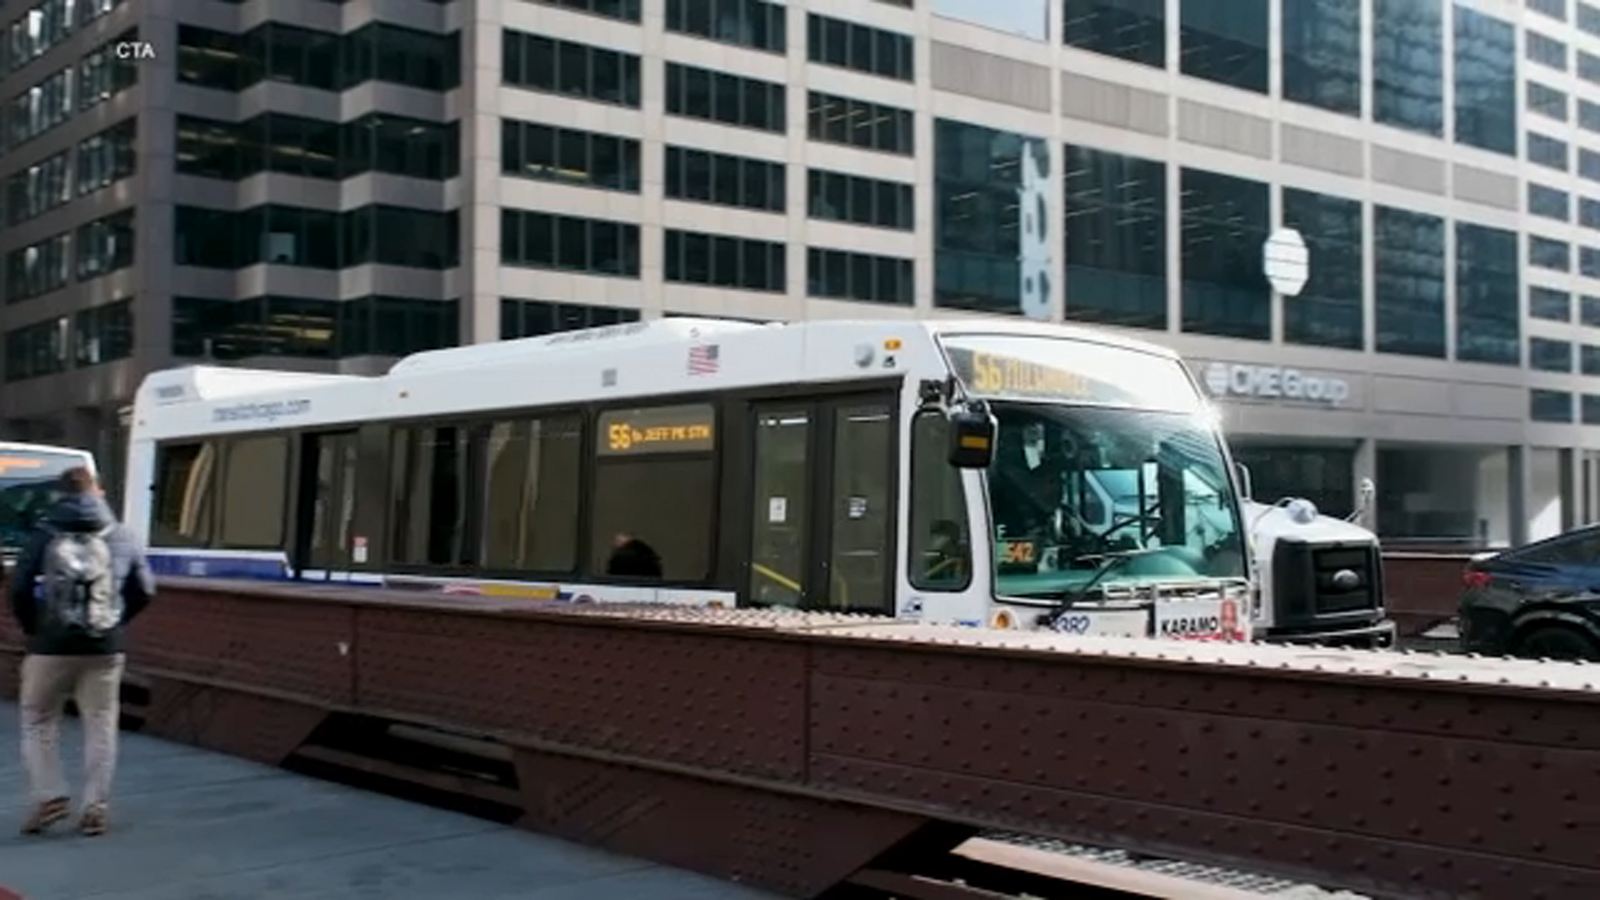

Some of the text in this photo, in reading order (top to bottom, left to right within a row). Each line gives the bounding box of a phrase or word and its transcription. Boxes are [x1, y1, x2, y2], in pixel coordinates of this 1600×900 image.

[974, 353, 1002, 391] 56
[609, 424, 631, 450] 56
[1161, 616, 1218, 635] KARAMO
